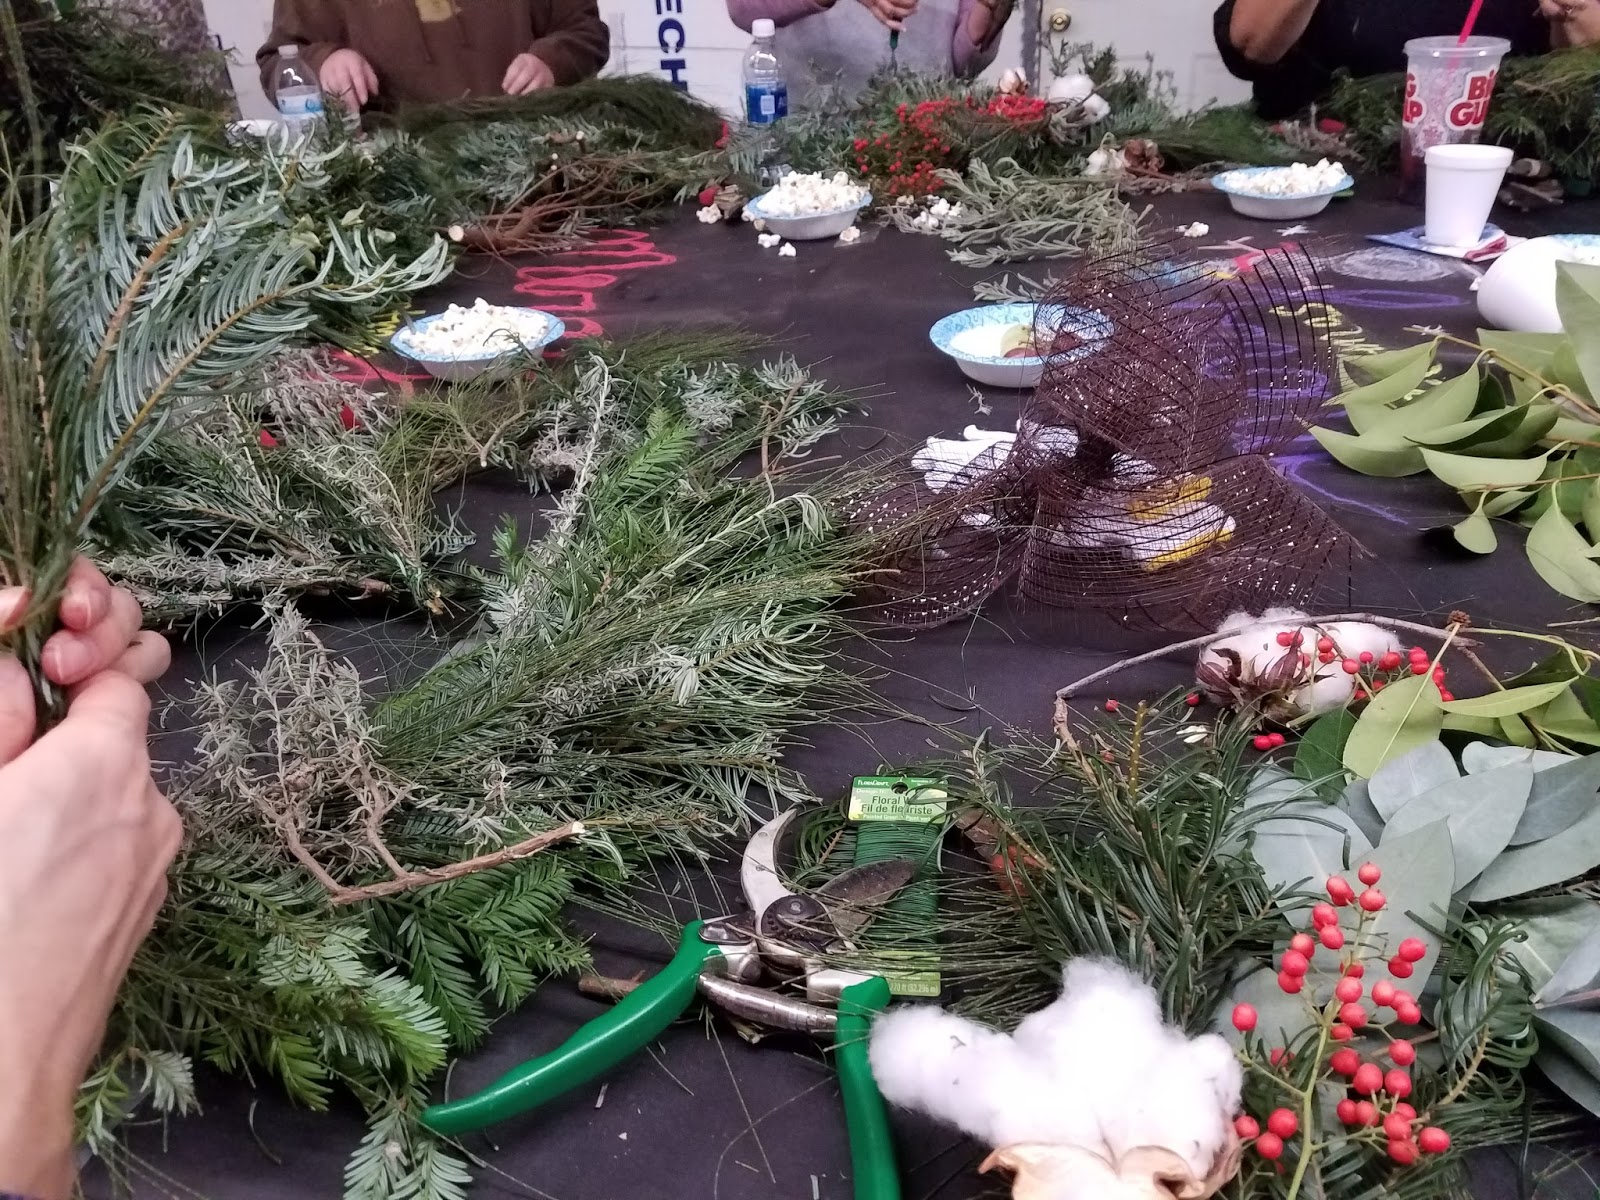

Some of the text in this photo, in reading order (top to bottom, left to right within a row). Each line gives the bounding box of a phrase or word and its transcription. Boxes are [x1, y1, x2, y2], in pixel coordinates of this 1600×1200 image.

[872, 796, 900, 804] Floral
[861, 804, 873, 812] Fil
[875, 804, 888, 813] de
